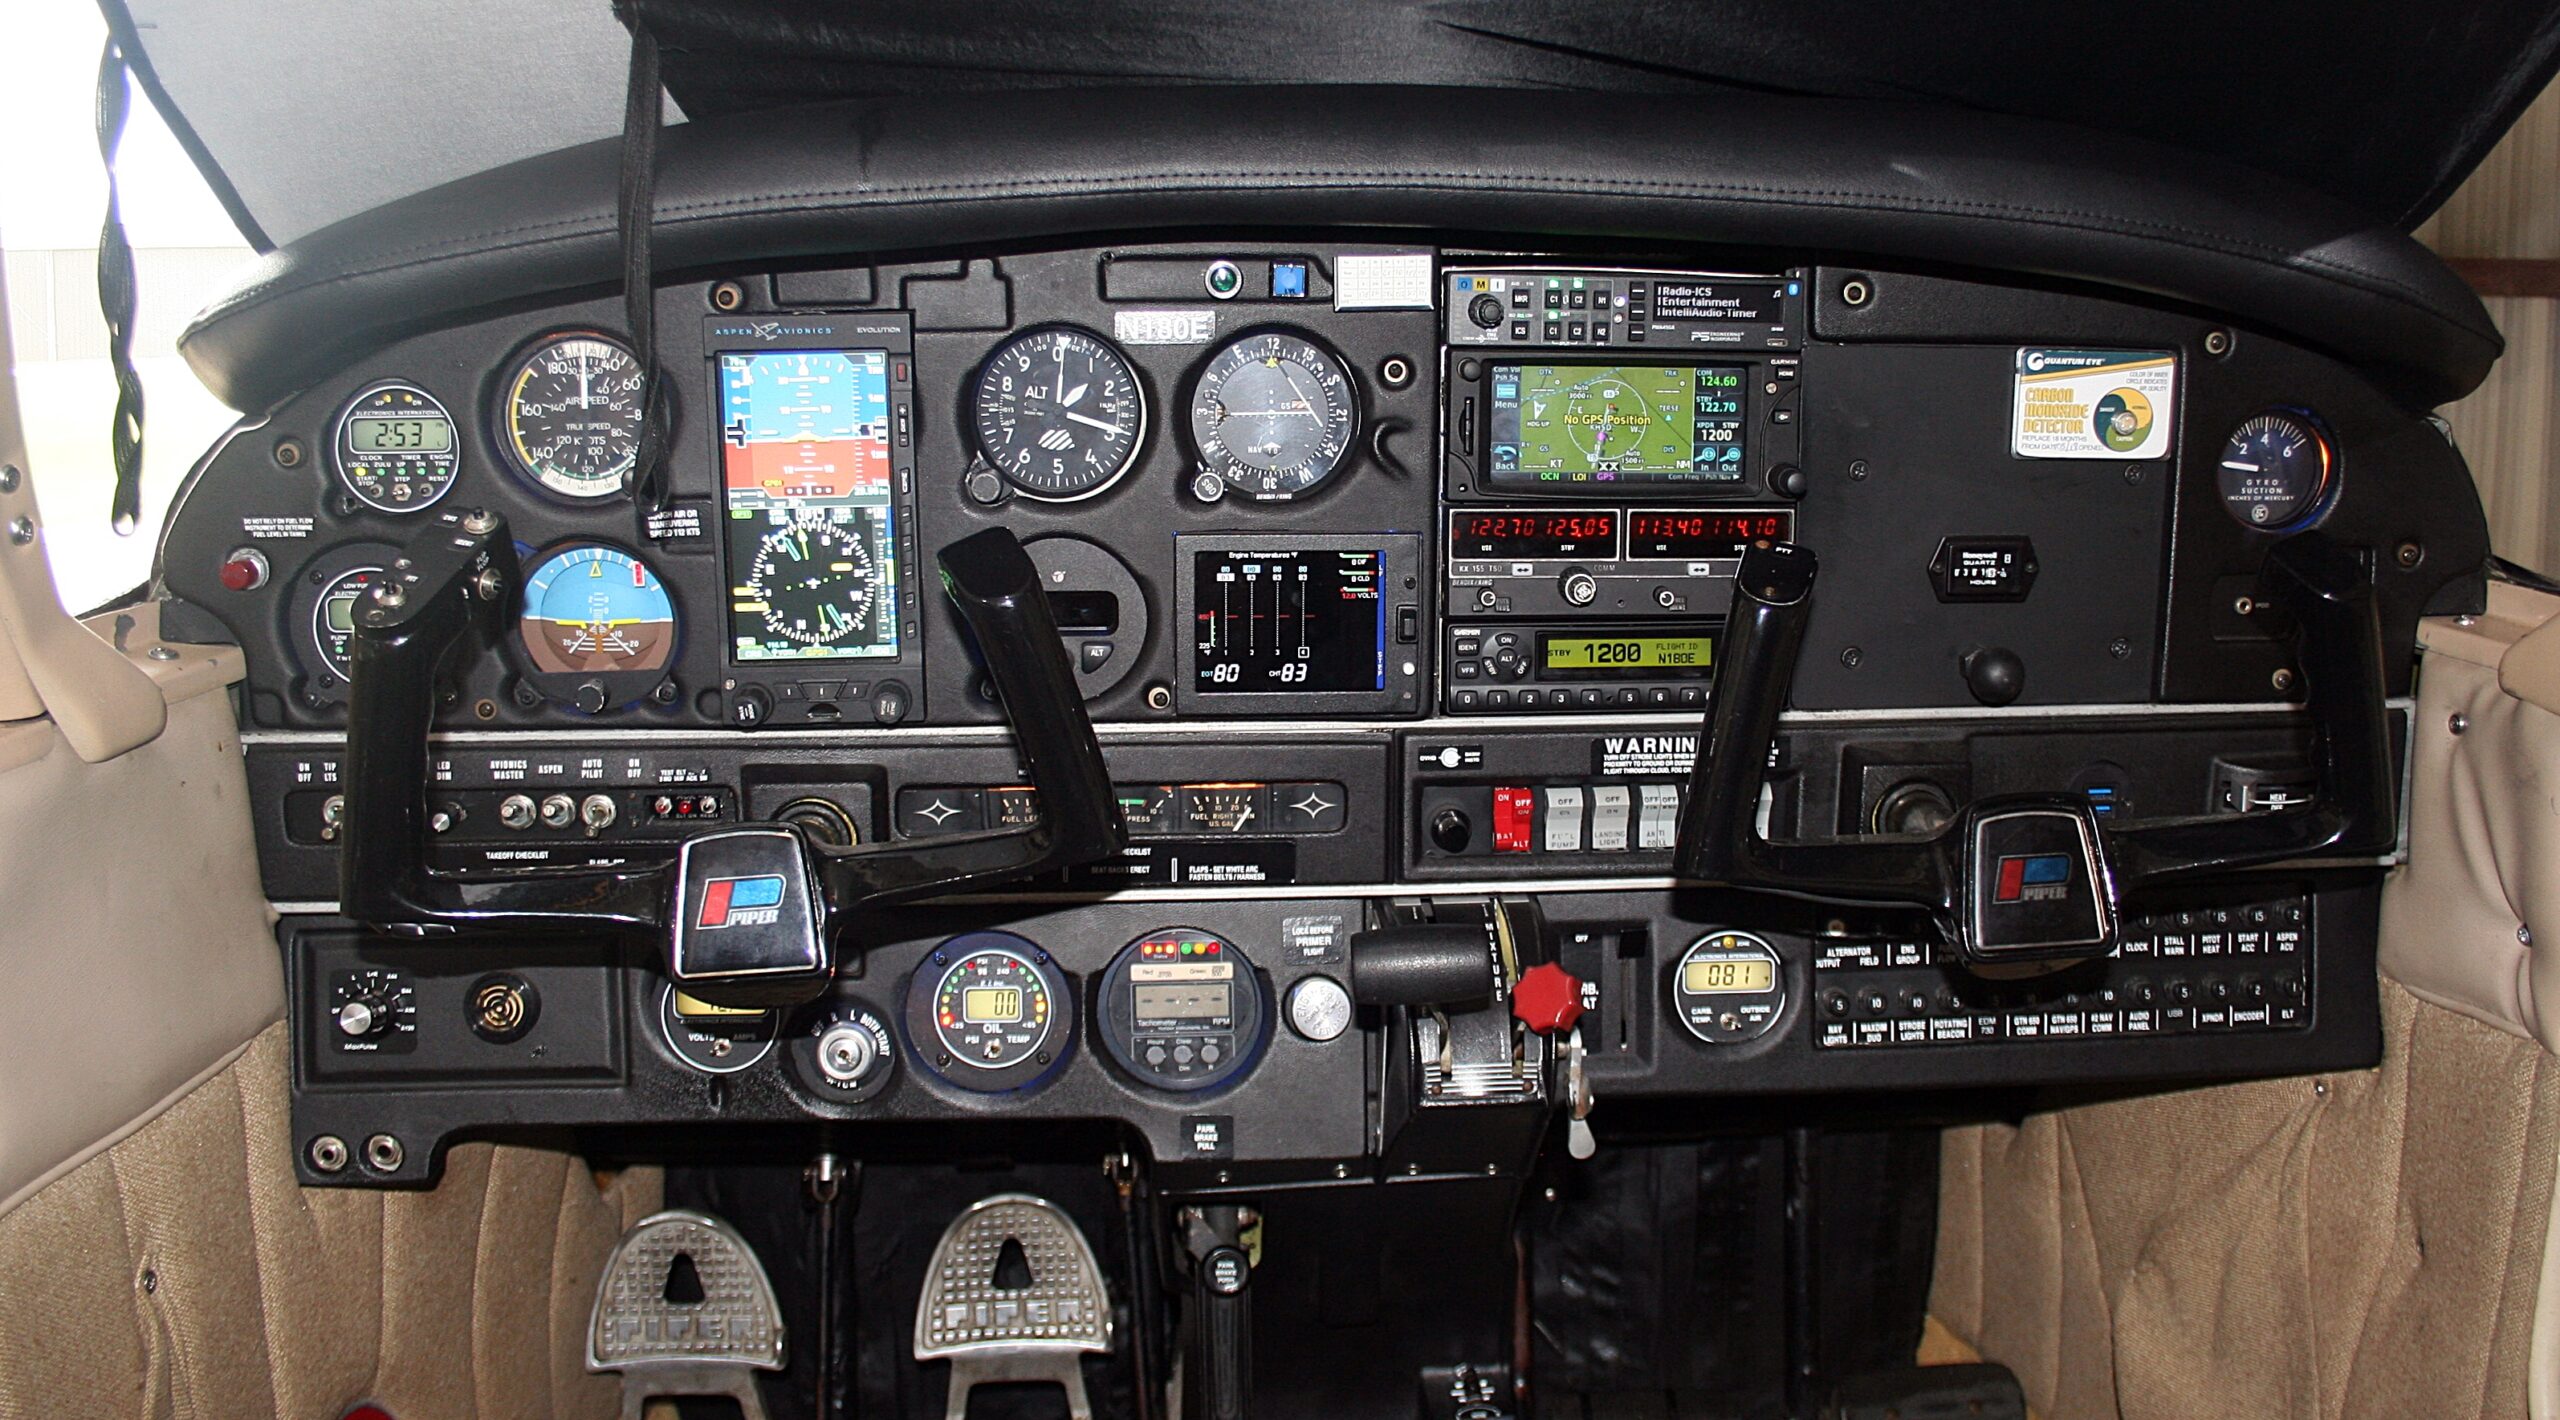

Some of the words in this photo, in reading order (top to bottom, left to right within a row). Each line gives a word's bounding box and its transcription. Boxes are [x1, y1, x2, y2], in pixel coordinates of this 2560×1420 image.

[1662, 286, 1712, 297] Radio-ICS
[1662, 297, 1740, 308] Entertainment
[1662, 308, 1757, 319] IntelliAudio-Timer
[715, 328, 752, 336] ASPEN
[777, 327, 832, 335] AVIONICS
[1119, 313, 1210, 341] N180E
[1549, 327, 1558, 335] C1
[1573, 327, 1582, 336] C2
[1267, 338, 1280, 350] 12
[1302, 346, 1316, 362] 15
[2044, 357, 2084, 366] QUANTUM
[2085, 358, 2102, 366] EYE
[548, 362, 568, 375] 180
[622, 377, 641, 391] 60
[1701, 376, 1737, 387] 124.60
[1024, 385, 1049, 399] ALT
[1574, 384, 1589, 392] Auto
[2026, 387, 2074, 403] CARBON
[609, 402, 622, 412] 60
[1495, 400, 1518, 409] Menu
[1700, 402, 1737, 413] 122.70
[521, 404, 542, 417] 160
[1336, 408, 1348, 423] 21
[2024, 403, 2090, 418] MONOXIDE
[1563, 414, 1578, 425] No
[1582, 414, 1603, 425] GPS
[1607, 413, 1651, 425] Position
[2023, 419, 2085, 434] DETECTOR
[375, 422, 423, 448] 2:53
[610, 428, 623, 438] 80
[1701, 429, 1733, 442] 1200
[533, 446, 554, 460] 140
[587, 446, 604, 456] 100
[1247, 446, 1262, 454] NAV
[1324, 441, 1339, 459] 24
[1495, 461, 1516, 470] Back
[1550, 459, 1563, 469] KT
[1701, 463, 1709, 471] In
[1722, 463, 1737, 472] Out
[1227, 466, 1245, 482] 33
[1540, 472, 1560, 480] OCN
[1572, 472, 1586, 481] LOI
[1597, 472, 1615, 481] GPS
[1200, 478, 1218, 496] OBS
[1263, 477, 1278, 490] 30
[2246, 479, 2279, 487] GYRO
[2241, 487, 2283, 495] SUCTION
[1470, 518, 1536, 537] 122.70
[1546, 518, 1610, 538] 125.05
[1638, 518, 1703, 537] 113.40
[1713, 518, 1777, 537] 114.10
[1962, 551, 1998, 560] Honeywell
[1500, 636, 1513, 644] ON
[1458, 644, 1478, 652] IDENT
[1655, 642, 1686, 650] FLIGHT
[1688, 642, 1698, 650] ID
[1090, 649, 1105, 657] ALT
[1547, 649, 1571, 657] STBY
[1583, 642, 1641, 664] 1200
[1658, 652, 1696, 664] N180E
[1201, 670, 1213, 678] EGT
[1213, 663, 1241, 683] 80
[1281, 663, 1308, 683] 83
[1605, 737, 1695, 754] WARNIN
[323, 763, 337, 772] TIP
[437, 761, 451, 771] LED
[490, 760, 527, 770] AVIONICS
[582, 758, 603, 769] AUTO
[629, 757, 640, 768] ON
[538, 765, 563, 774] ASPEN
[581, 769, 603, 779] PILOT
[627, 768, 642, 779] OFF
[298, 773, 312, 782] OFF
[324, 773, 337, 782] LTS
[437, 772, 452, 781] DIM
[494, 770, 525, 780] MASTER
[1497, 794, 1510, 802] ON
[1515, 799, 1532, 807] OFF
[1558, 798, 1573, 806] OFF
[1605, 795, 1620, 803] OFF
[1126, 815, 1151, 823] PRESS
[1190, 812, 1209, 821] FUEL
[1213, 812, 1233, 820] RIGHT
[1513, 840, 1529, 848] ALT
[1599, 838, 1620, 846] LIGHT
[486, 851, 515, 860] TAKEOFF
[515, 850, 549, 860] CHECKLIST
[1130, 865, 1151, 874] ERECT
[1189, 865, 1209, 874] FLAPS
[1213, 865, 1225, 874] SET
[1226, 865, 1246, 874] WHITE
[1247, 865, 1259, 873] ARC
[2022, 885, 2068, 901] PIPER
[729, 909, 780, 926] PIPER
[2217, 911, 2227, 923] 15
[2255, 910, 2264, 922] 15
[1296, 936, 1332, 947] PRIMER
[1574, 934, 1589, 943] OFF
[2164, 936, 2185, 946] STALL
[2202, 934, 2221, 944] PITOT
[2238, 932, 2259, 943] START
[2276, 931, 2298, 942] ASPEN
[1826, 947, 1872, 957] ALTERNATOR
[1900, 944, 1916, 955] ENG
[2125, 942, 2149, 952] CLOCK
[2202, 944, 2221, 954] HEAT
[1303, 948, 1325, 957] FLIGHT
[1484, 922, 1503, 1003] MIXTURE
[1859, 956, 1880, 966] FIELD
[1895, 955, 1921, 965] GROUP
[1707, 963, 1750, 987] 081
[994, 991, 1017, 1016] 00
[1740, 1005, 1771, 1014] OUTSIDE
[2167, 1008, 2184, 1018] USB
[2281, 1008, 2294, 1019] ELT
[1749, 1013, 1762, 1022] AIR
[2129, 1011, 2150, 1021] AUDIO
[2234, 1010, 2265, 1021] ENCODER
[860, 1012, 880, 1034] BOTH
[1899, 1020, 1926, 1031] STROBE
[1934, 1018, 1968, 1029] ROTATING
[2091, 1022, 2113, 1033] COMM
[2128, 1020, 2150, 1031] PANEL
[982, 1023, 1003, 1034] OIL
[1828, 1024, 1843, 1034] NAV
[2016, 1025, 2038, 1036] COMM
[1900, 1030, 1925, 1041] LIGHTS
[1936, 1029, 1966, 1039] BEACON
[875, 1024, 891, 1057] START
[965, 1035, 980, 1044] PSI
[1006, 1035, 1031, 1044] TEMP
[1823, 1035, 1848, 1045] LIGHTS
[1196, 1123, 1216, 1133] PARK
[1194, 1132, 1219, 1142] BRAKE
[1196, 1141, 1215, 1151] PULL
[944, 1302, 1085, 1329] PIPER
[617, 1315, 757, 1342] PIPER
